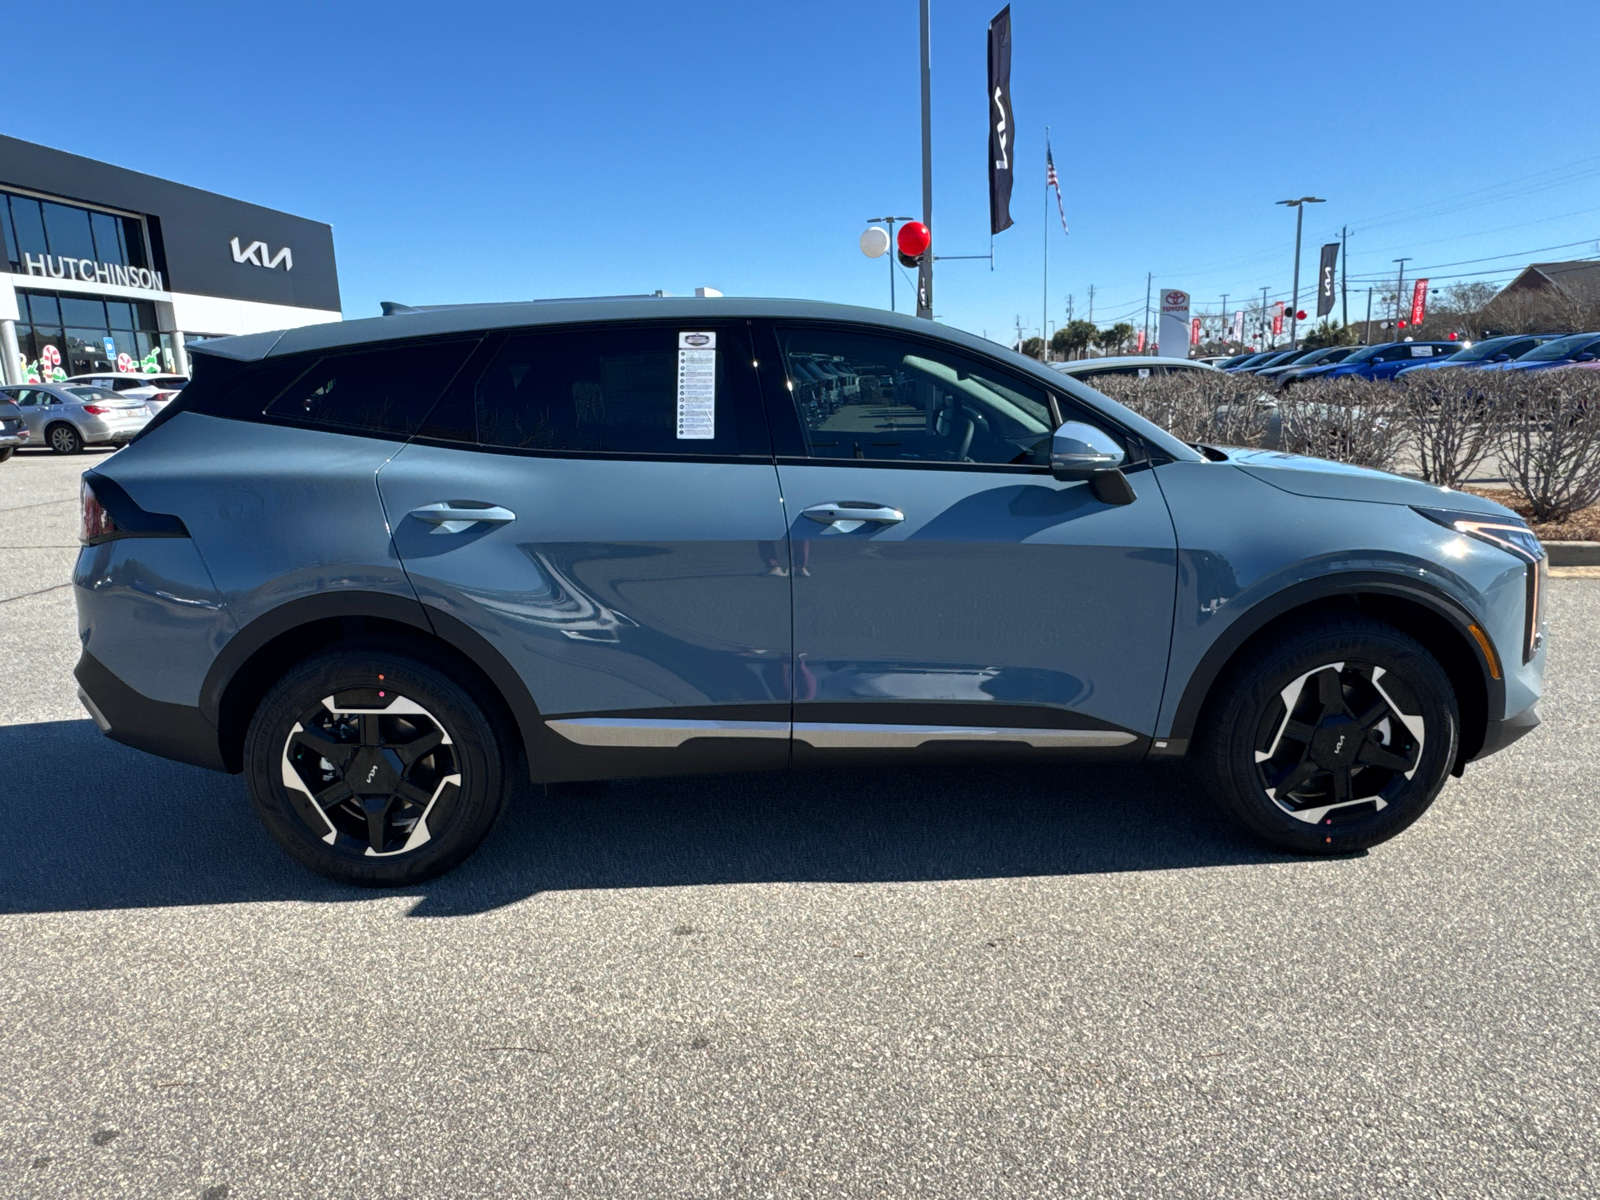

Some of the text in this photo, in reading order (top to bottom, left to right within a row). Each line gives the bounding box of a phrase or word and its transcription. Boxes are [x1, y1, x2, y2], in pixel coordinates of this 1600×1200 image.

[230, 236, 294, 271] KIA
[24, 252, 164, 291] HUTCHINSON
[1414, 289, 1425, 323] TOYOTA
